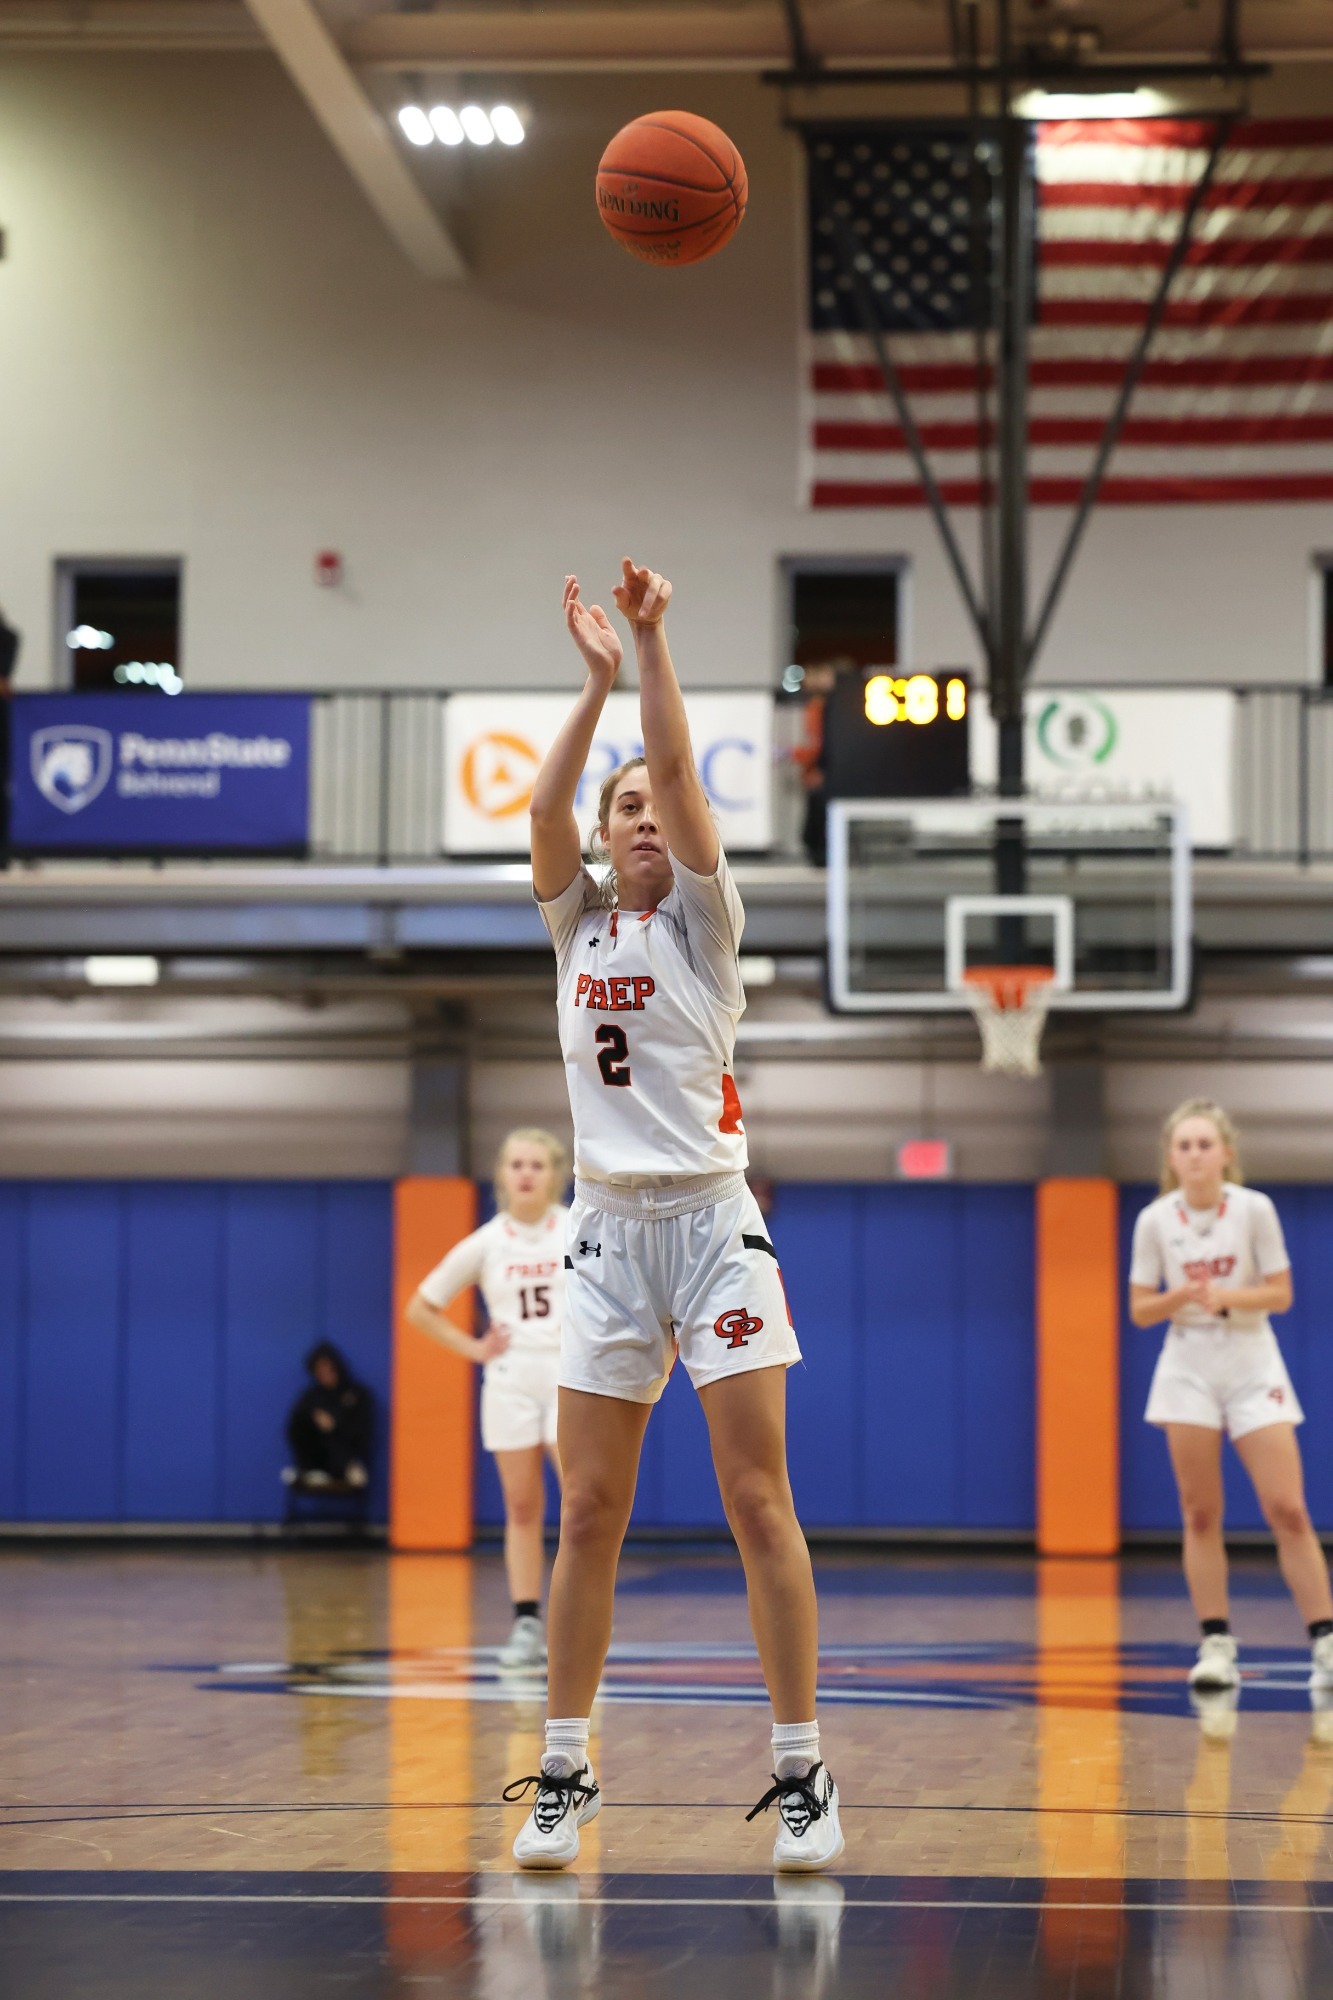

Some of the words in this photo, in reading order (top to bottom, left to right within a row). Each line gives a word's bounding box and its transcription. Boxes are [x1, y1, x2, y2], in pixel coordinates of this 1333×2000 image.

[864, 675, 966, 726] 6:01
[594, 1023, 632, 1087] 2
[519, 1286, 551, 1320] 15
